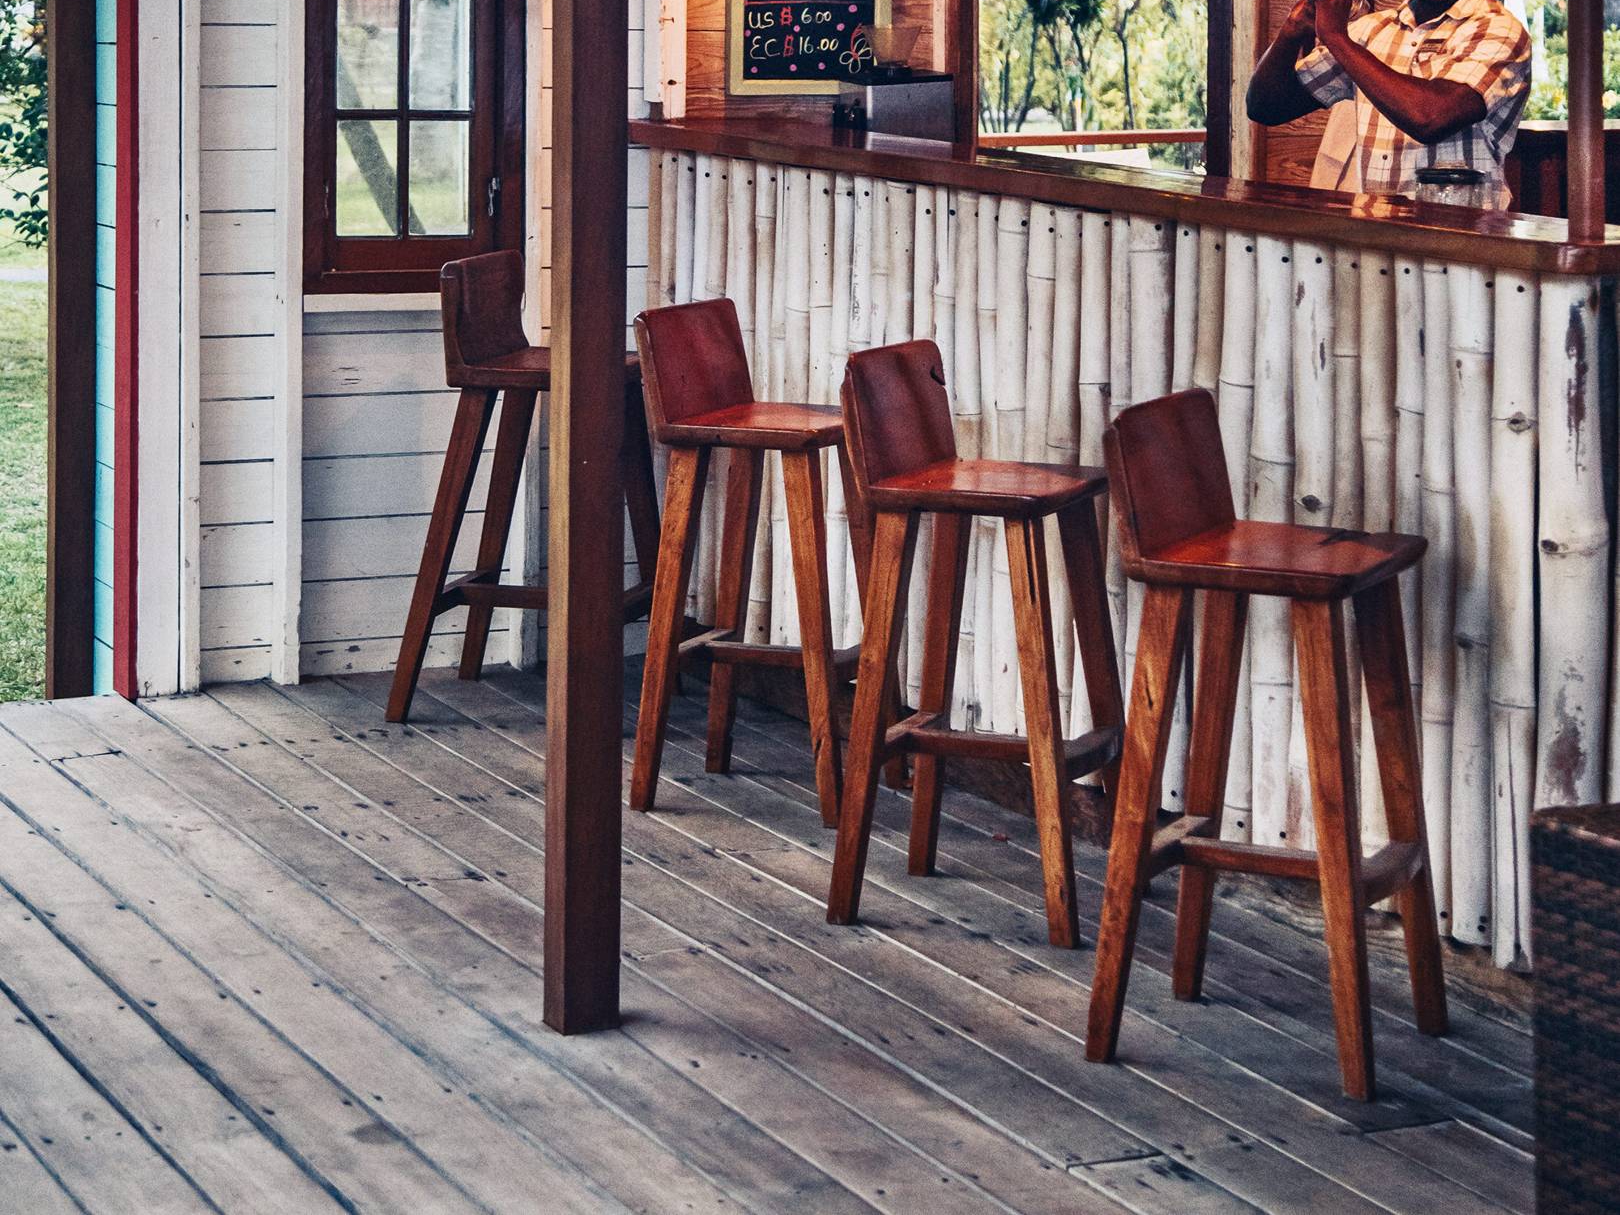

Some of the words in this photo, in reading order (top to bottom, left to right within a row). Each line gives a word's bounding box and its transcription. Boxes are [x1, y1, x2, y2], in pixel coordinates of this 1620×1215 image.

[748, 11, 775, 29] US
[749, 35, 781, 60] EC
[798, 35, 840, 55] 16.00
